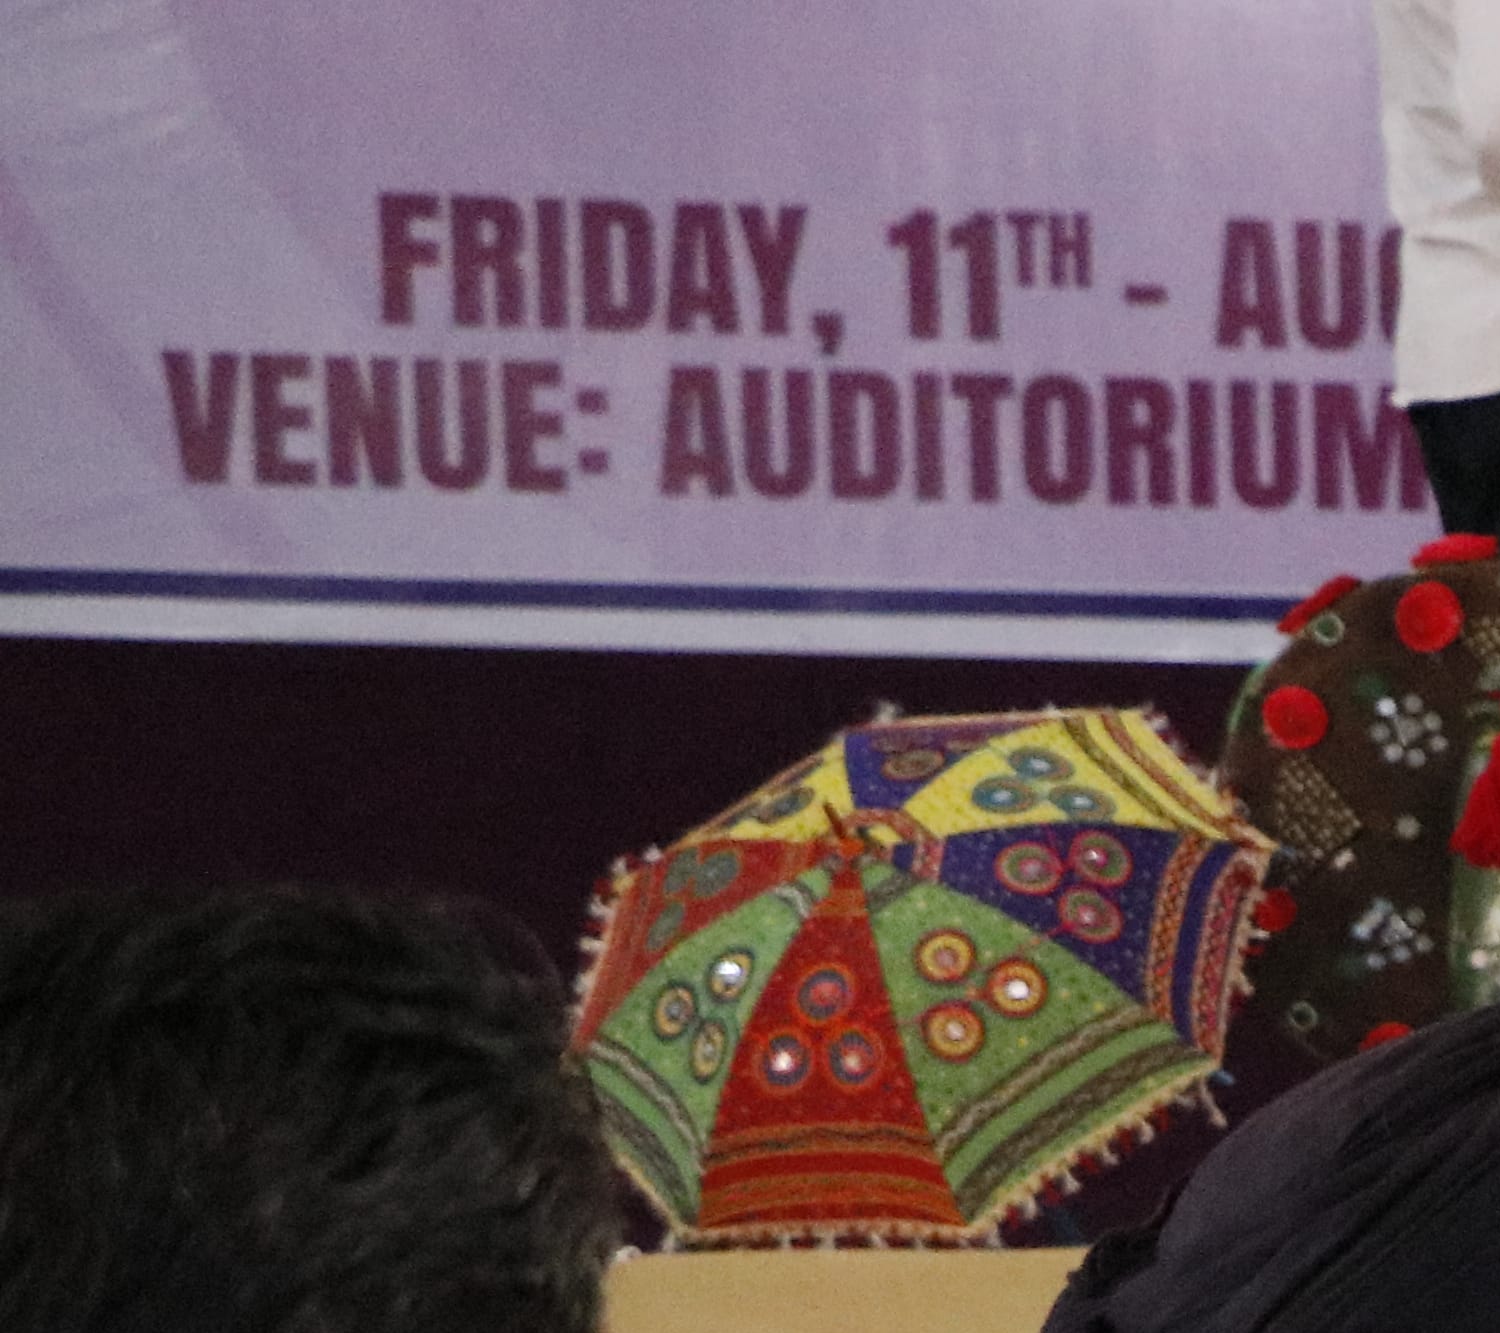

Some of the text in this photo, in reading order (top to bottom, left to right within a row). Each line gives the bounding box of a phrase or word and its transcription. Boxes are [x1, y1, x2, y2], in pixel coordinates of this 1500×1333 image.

[378, 191, 845, 356] FRIDAY,
[160, 348, 610, 493] VENUE:
[660, 362, 1432, 512] AUDITORIUM
